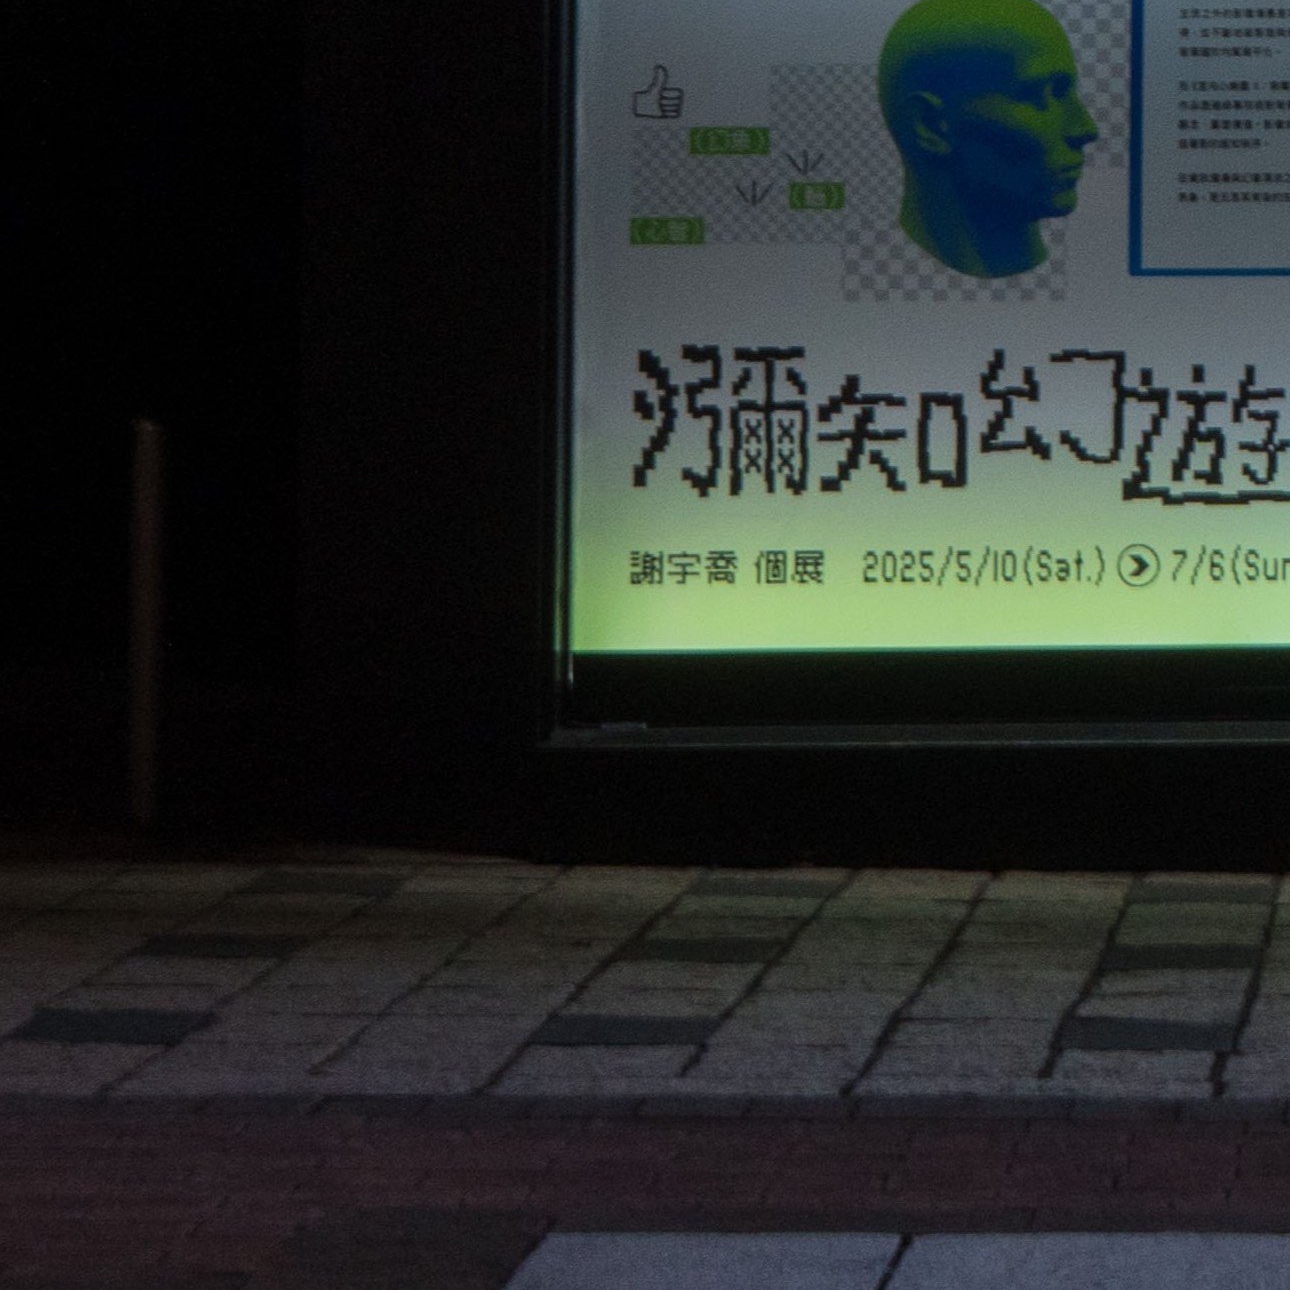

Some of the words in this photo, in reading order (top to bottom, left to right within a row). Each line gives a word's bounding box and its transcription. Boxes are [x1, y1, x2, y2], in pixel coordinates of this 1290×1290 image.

[630, 550, 738, 584] 謝宇喬
[754, 550, 824, 584] 個展
[862, 545, 1106, 586] 2025/5/10(Sat.)
